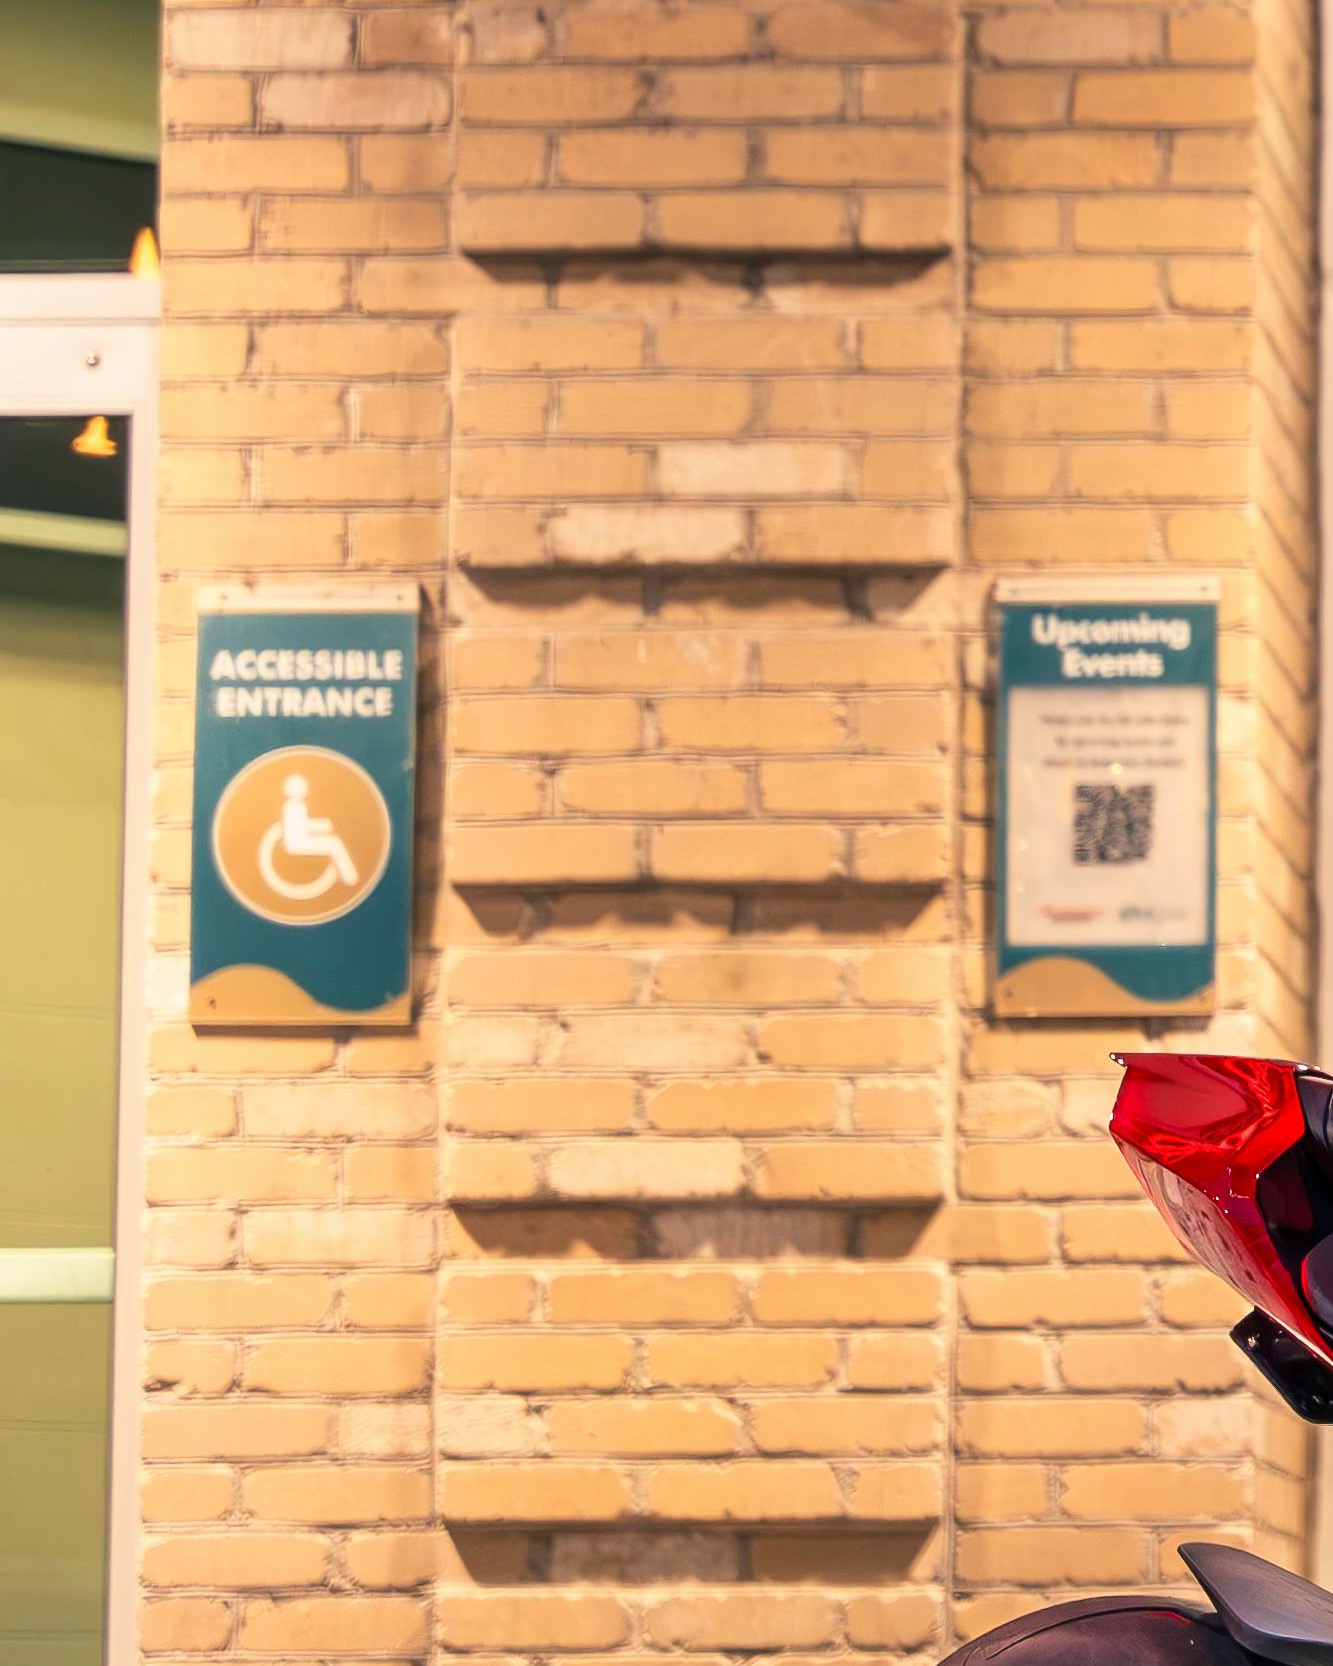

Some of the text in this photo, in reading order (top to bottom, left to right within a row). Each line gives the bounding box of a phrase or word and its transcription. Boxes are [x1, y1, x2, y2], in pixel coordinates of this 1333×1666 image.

[1032, 611, 1191, 650] Upcoming
[210, 649, 403, 681] ACCESSIBLE
[1062, 649, 1164, 678] Events
[215, 686, 394, 718] ENTRANCE
